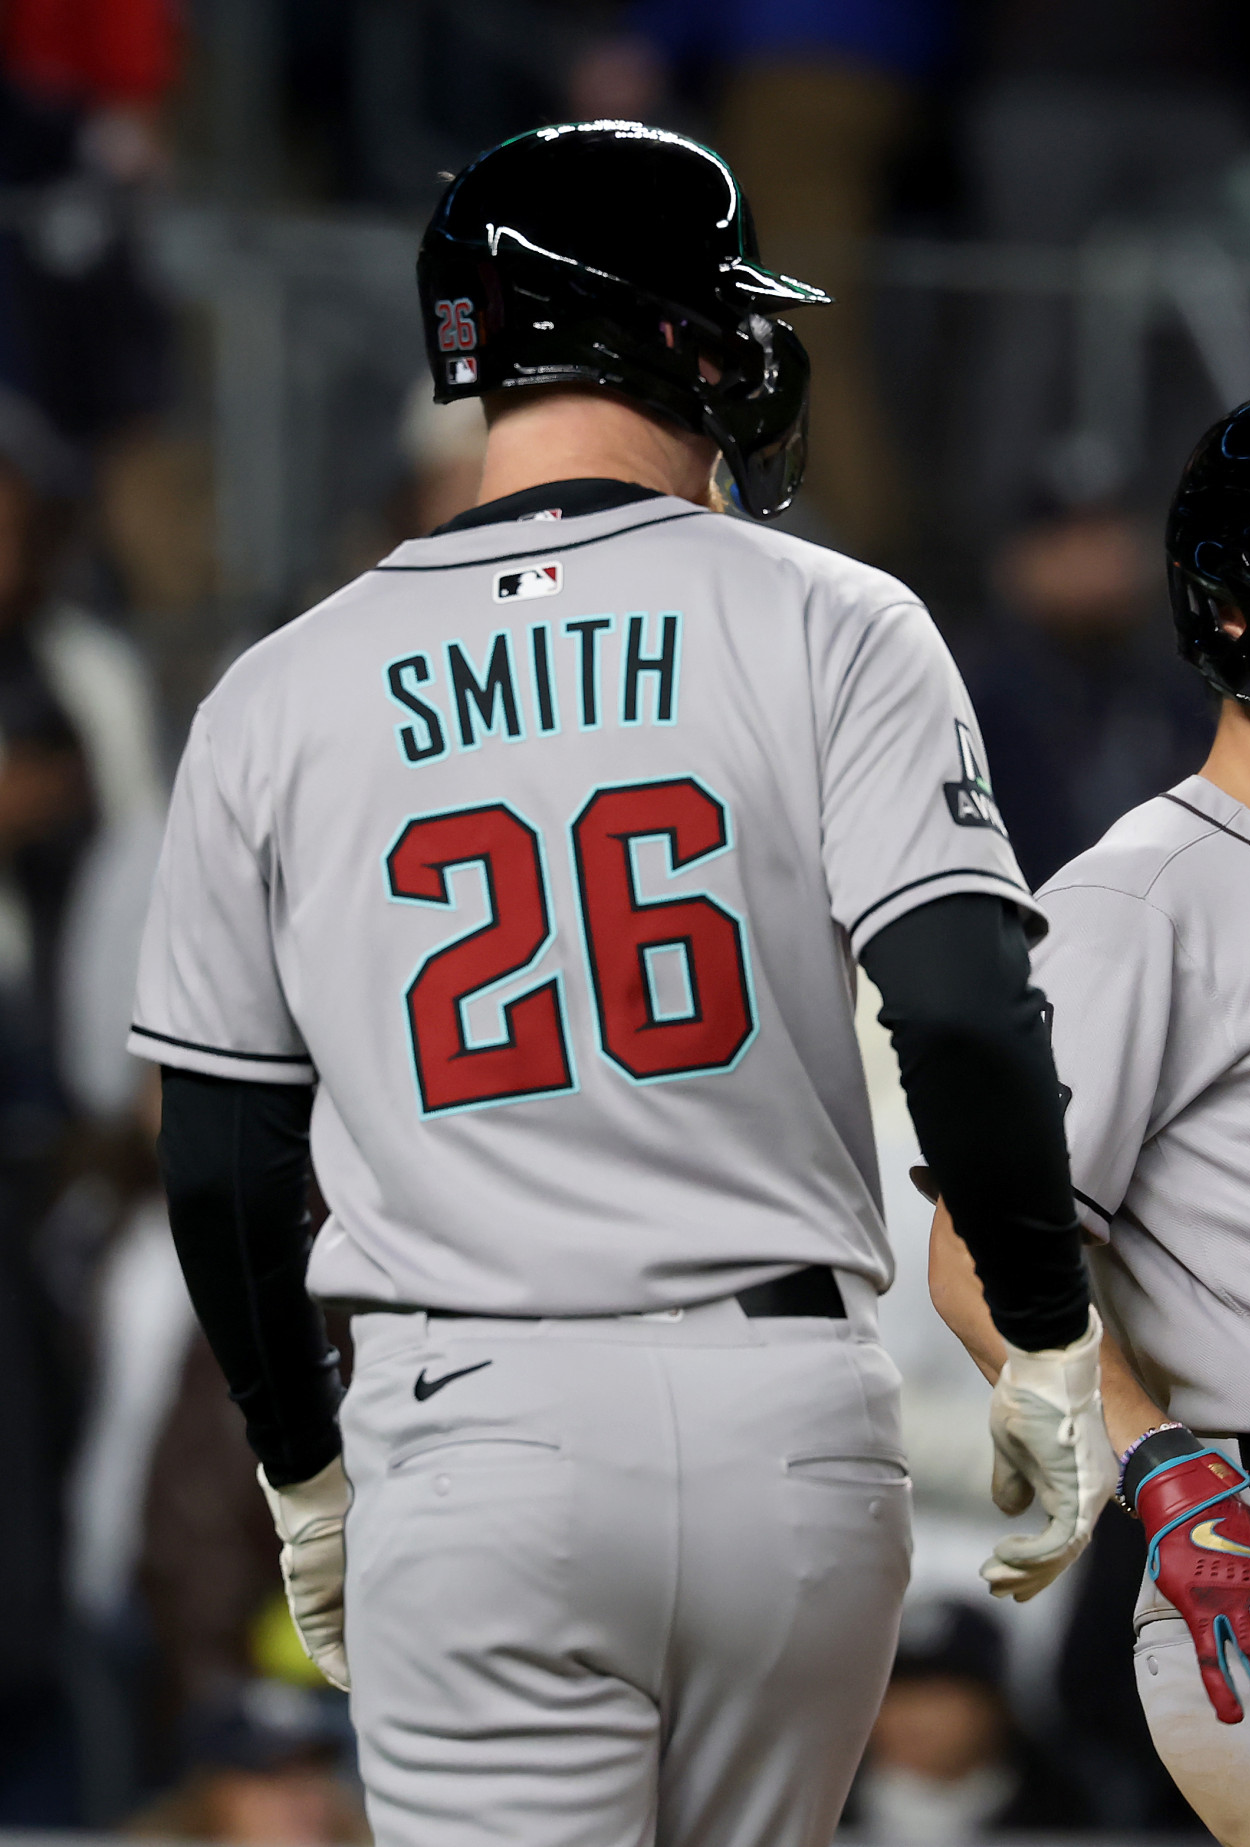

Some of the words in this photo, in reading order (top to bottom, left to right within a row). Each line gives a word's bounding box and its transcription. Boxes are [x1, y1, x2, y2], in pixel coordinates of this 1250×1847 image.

[434, 297, 477, 352] 26
[381, 610, 682, 769] SMITH
[381, 771, 760, 1121] 26
